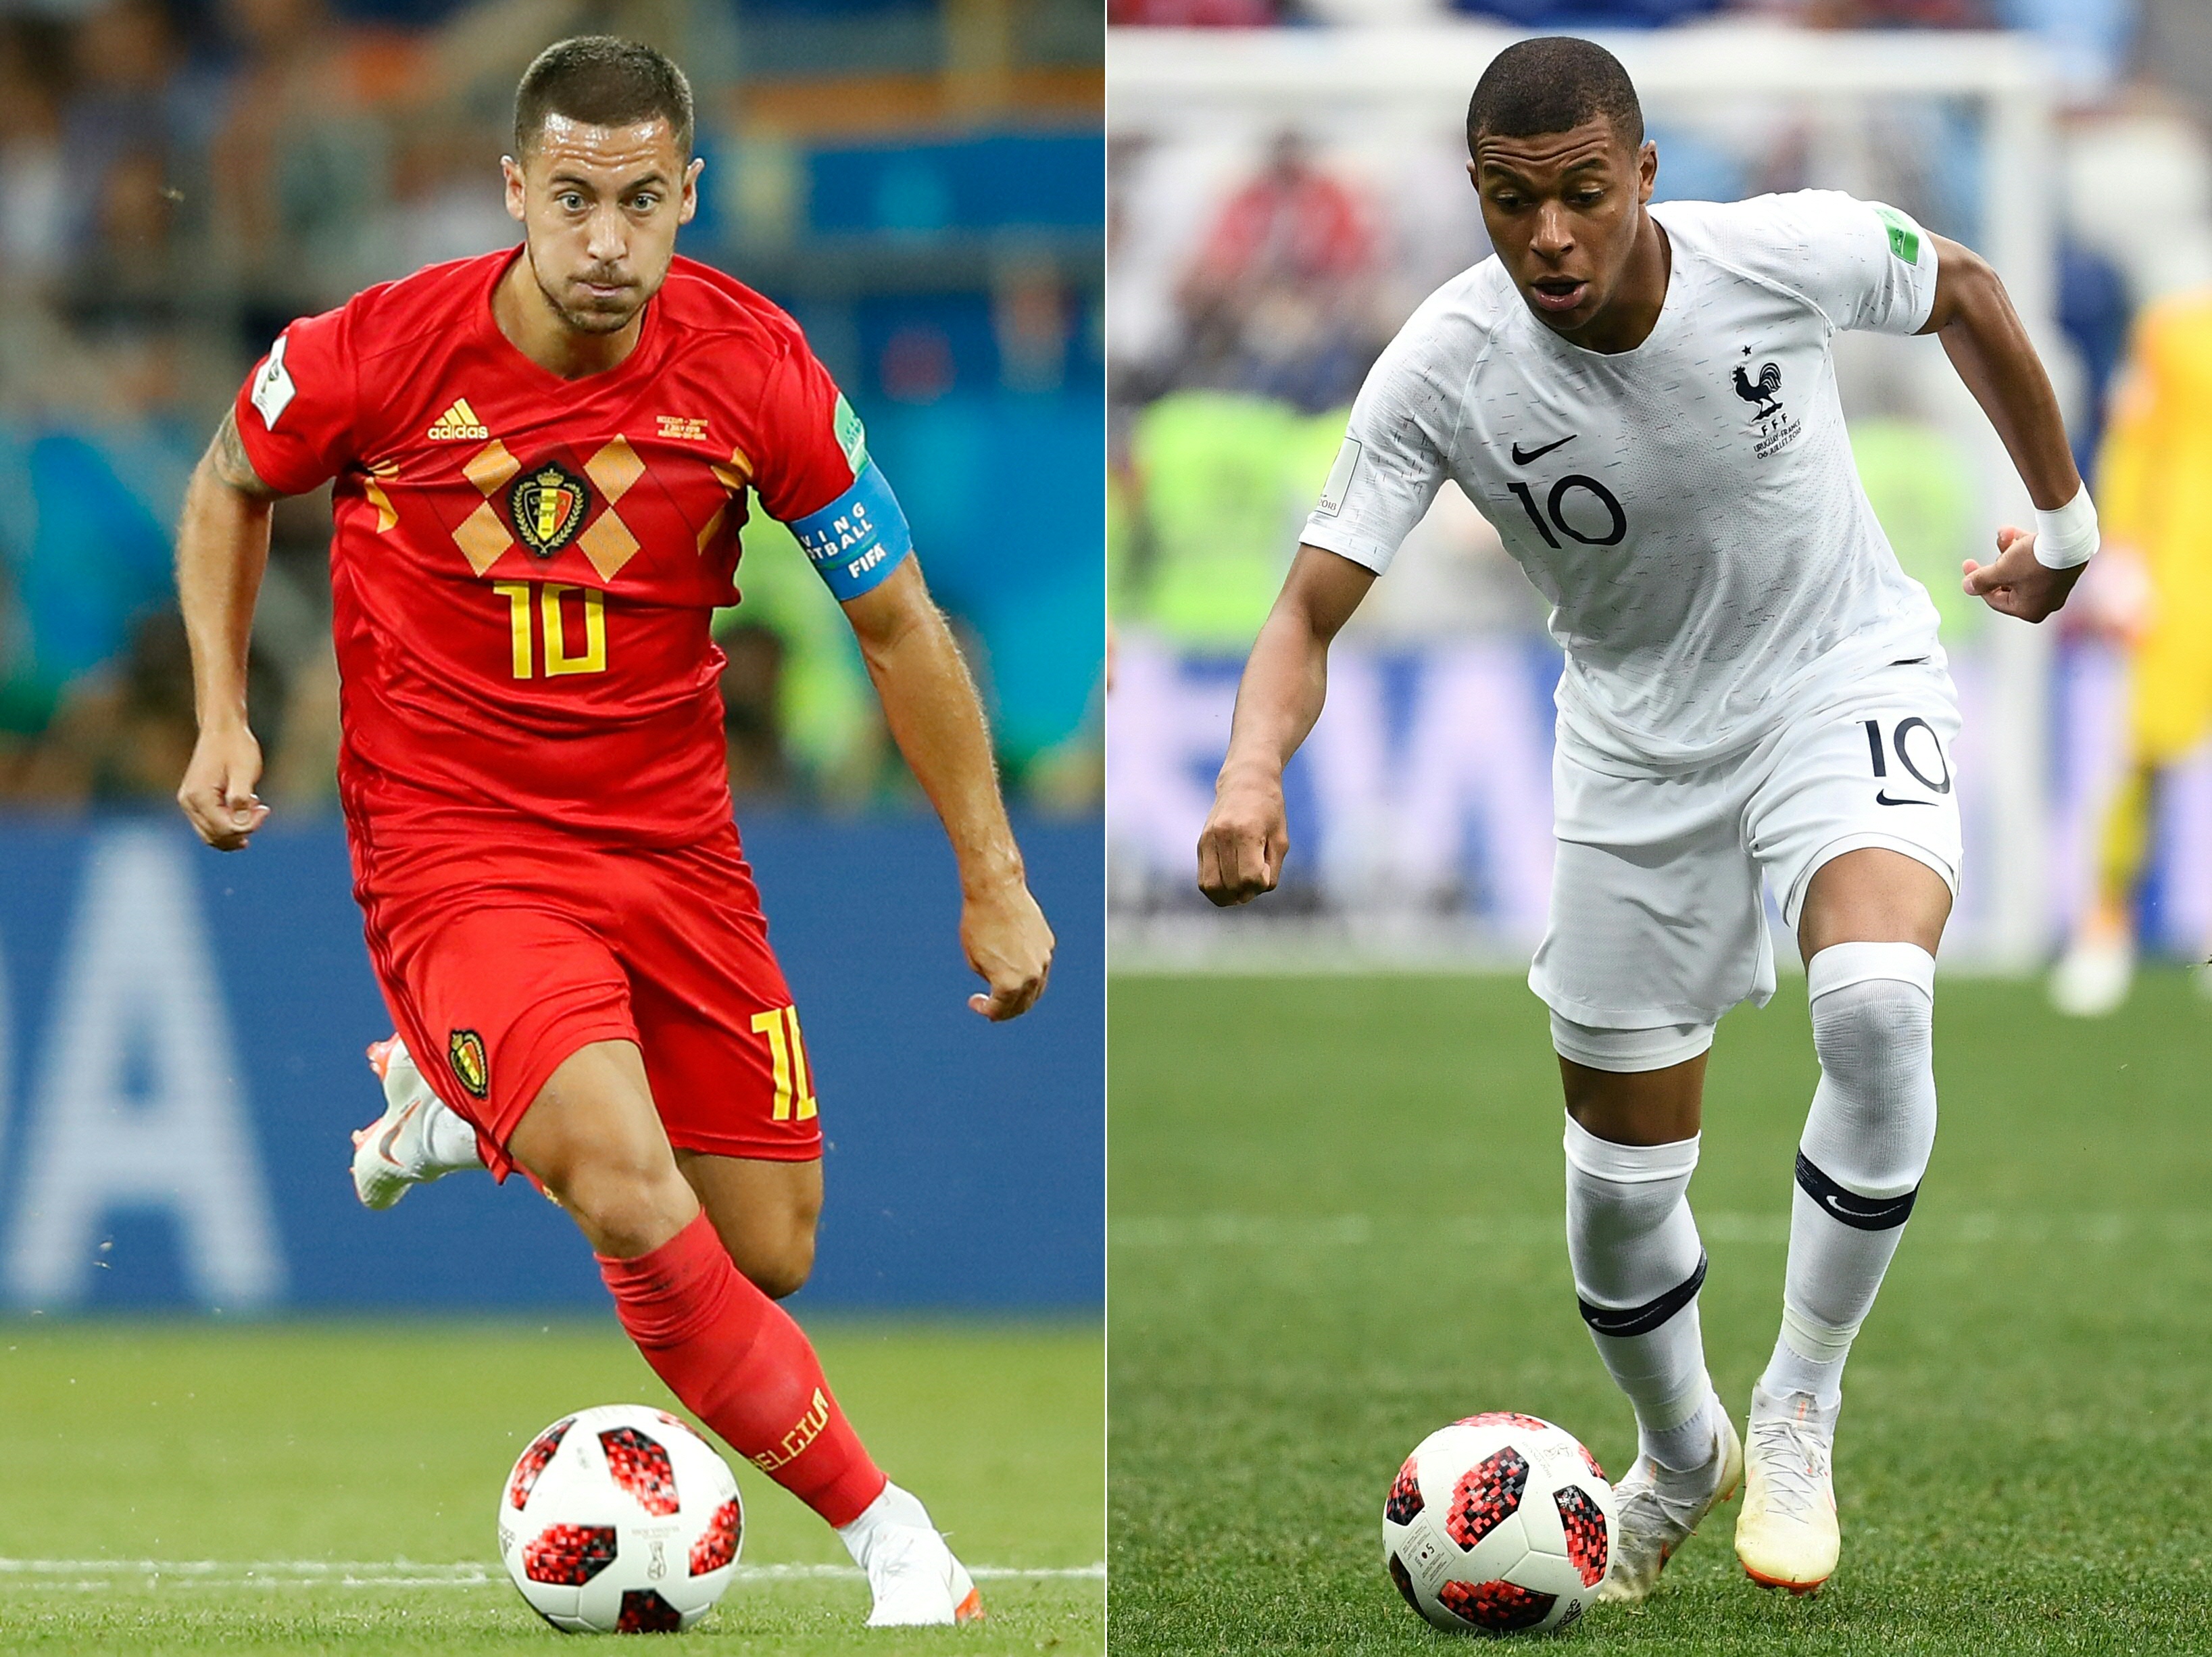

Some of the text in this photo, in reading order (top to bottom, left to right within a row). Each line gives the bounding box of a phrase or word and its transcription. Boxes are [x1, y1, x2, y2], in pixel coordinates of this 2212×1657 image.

[427, 425, 489, 440] adidas
[1756, 451, 1769, 460] 06
[1506, 474, 1627, 549] 10
[847, 543, 887, 578] FIFA
[493, 580, 606, 679] 10
[1856, 716, 1950, 795] 10
